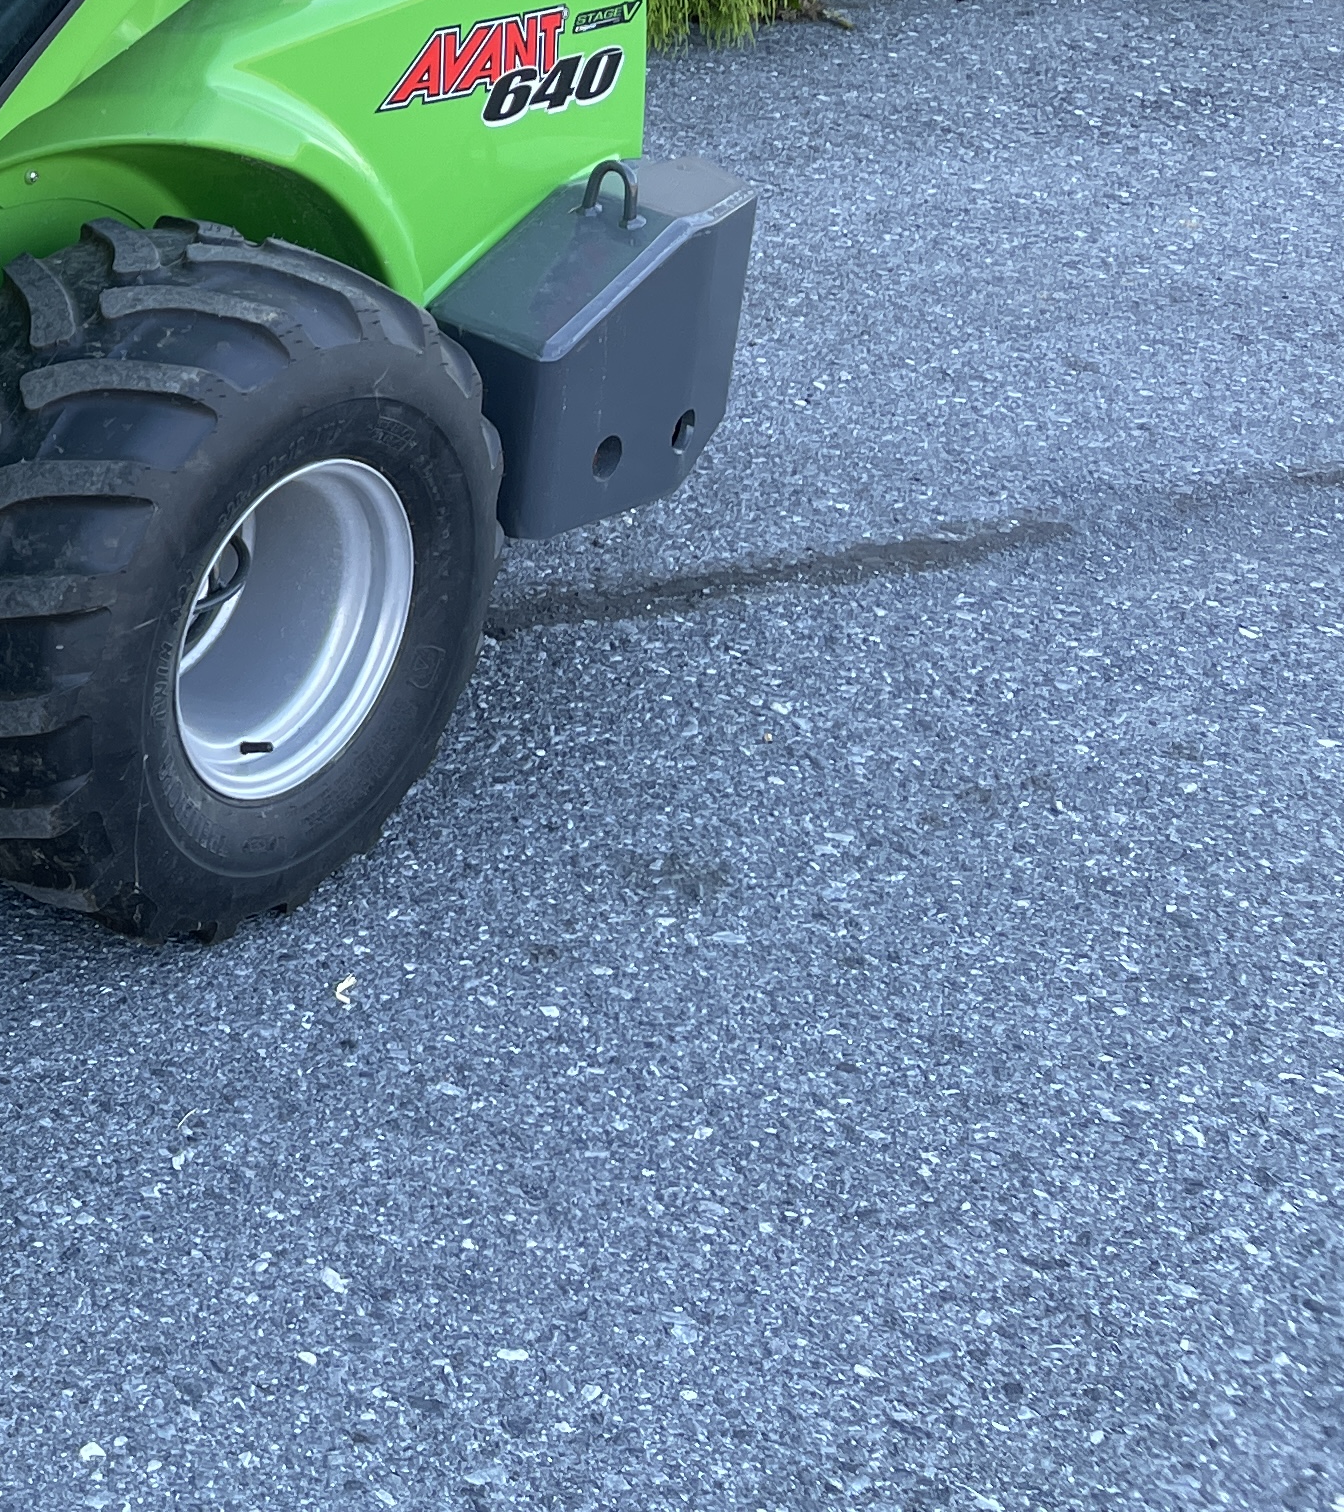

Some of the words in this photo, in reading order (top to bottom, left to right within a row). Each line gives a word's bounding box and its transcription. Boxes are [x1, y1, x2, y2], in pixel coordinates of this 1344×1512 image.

[576, 6, 622, 25] STAGE
[623, 0, 640, 20] V
[378, 6, 565, 110] AVANT
[482, 46, 623, 125] 640
